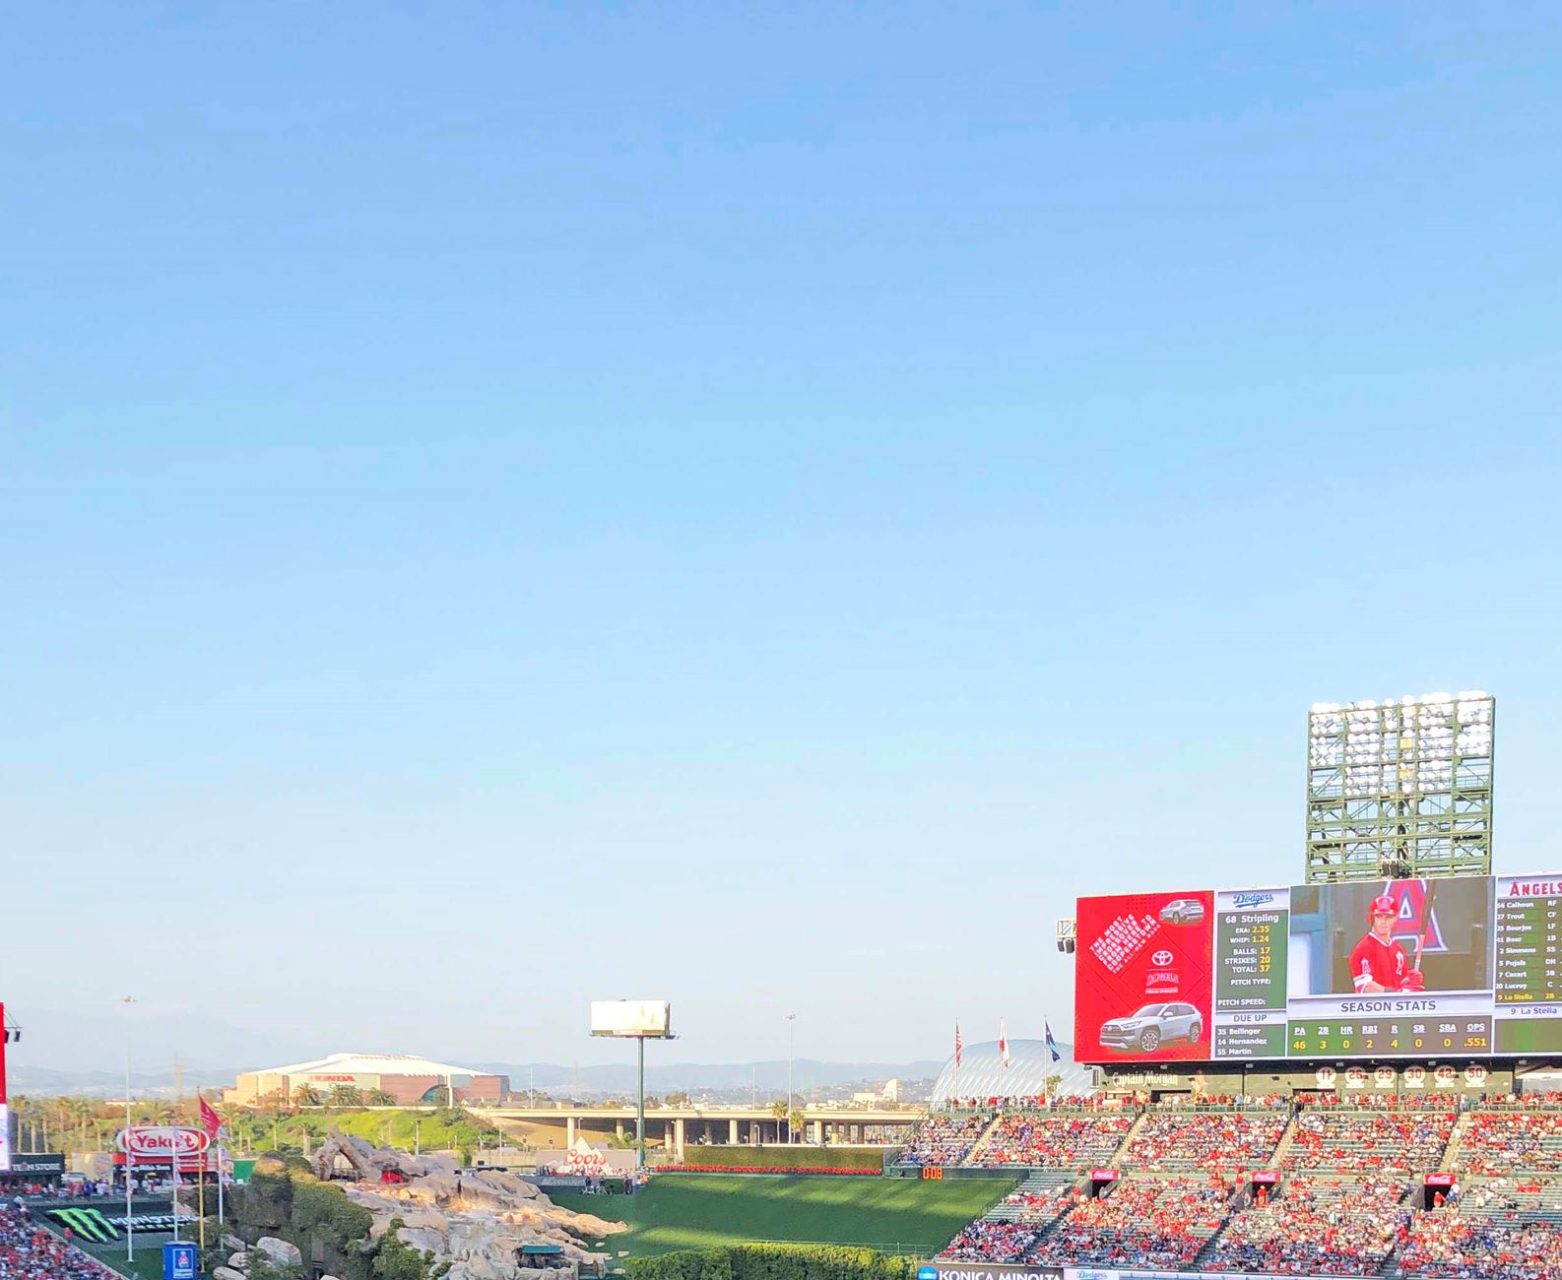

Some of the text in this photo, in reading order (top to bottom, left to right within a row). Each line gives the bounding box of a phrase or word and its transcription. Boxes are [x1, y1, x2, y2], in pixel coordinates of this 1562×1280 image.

[1510, 880, 1562, 896] ANGELS
[1233, 893, 1274, 908] Dodgers
[1226, 913, 1279, 924] 68 Stripling
[1089, 916, 1122, 951] THE MOST
[1260, 956, 1271, 964] 20
[1260, 965, 1271, 973] 37
[1341, 1000, 1436, 1012] SEASON STATS
[1533, 1006, 1557, 1014] Stella
[1254, 1014, 1268, 1022] UP
[1294, 1027, 1306, 1035] PA
[1318, 1026, 1329, 1035] 2B
[1340, 1026, 1353, 1034] HR
[1362, 1026, 1378, 1034] RBI
[1413, 1025, 1425, 1033] SB
[1439, 1024, 1457, 1032] SBA
[1466, 1023, 1485, 1032] OPS
[1294, 1038, 1486, 1049] 46 3 0 2 4 0 0 .551
[1378, 1069, 1392, 1079] 29
[1408, 1069, 1422, 1078] 30
[1438, 1068, 1452, 1078] 42
[1468, 1068, 1482, 1078] 50
